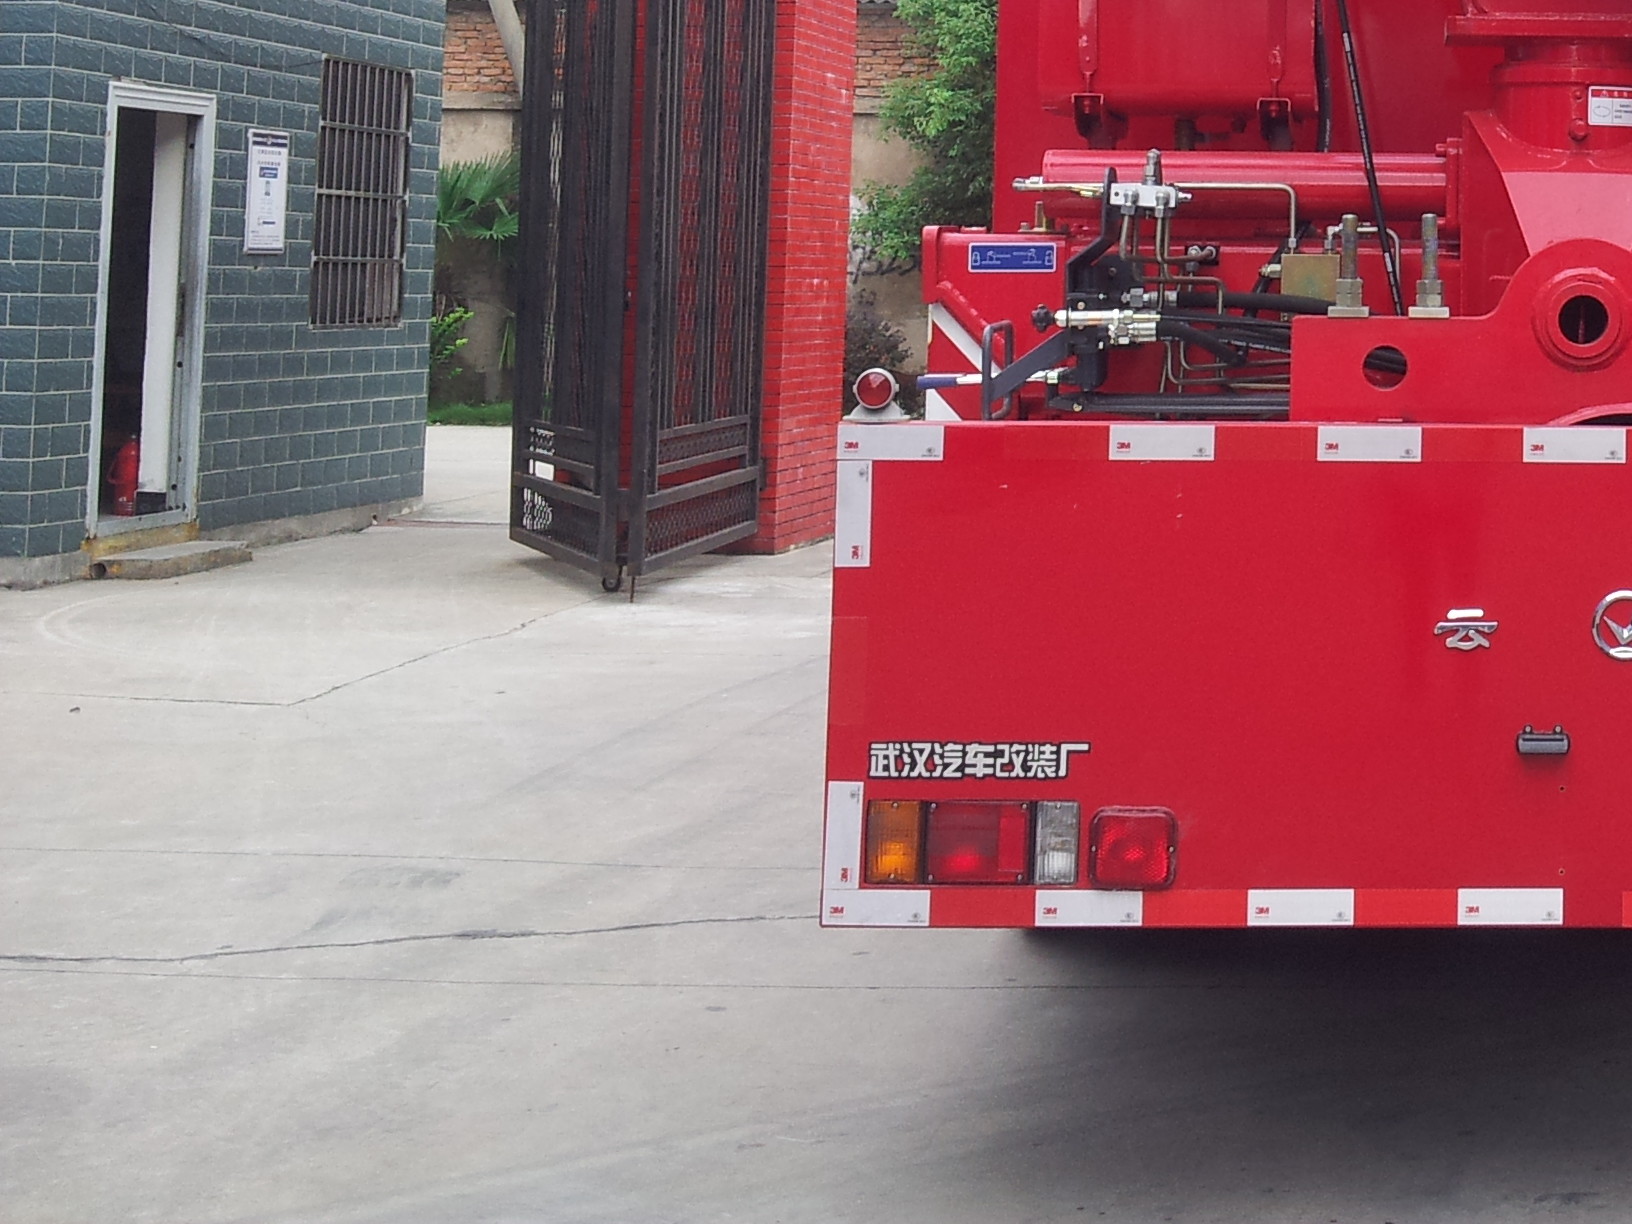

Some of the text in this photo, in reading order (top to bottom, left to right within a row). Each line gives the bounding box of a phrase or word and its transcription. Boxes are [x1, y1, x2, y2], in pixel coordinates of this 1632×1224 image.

[1434, 607, 1498, 651] 云
[868, 741, 1091, 779] 武汉汽车改装厂
